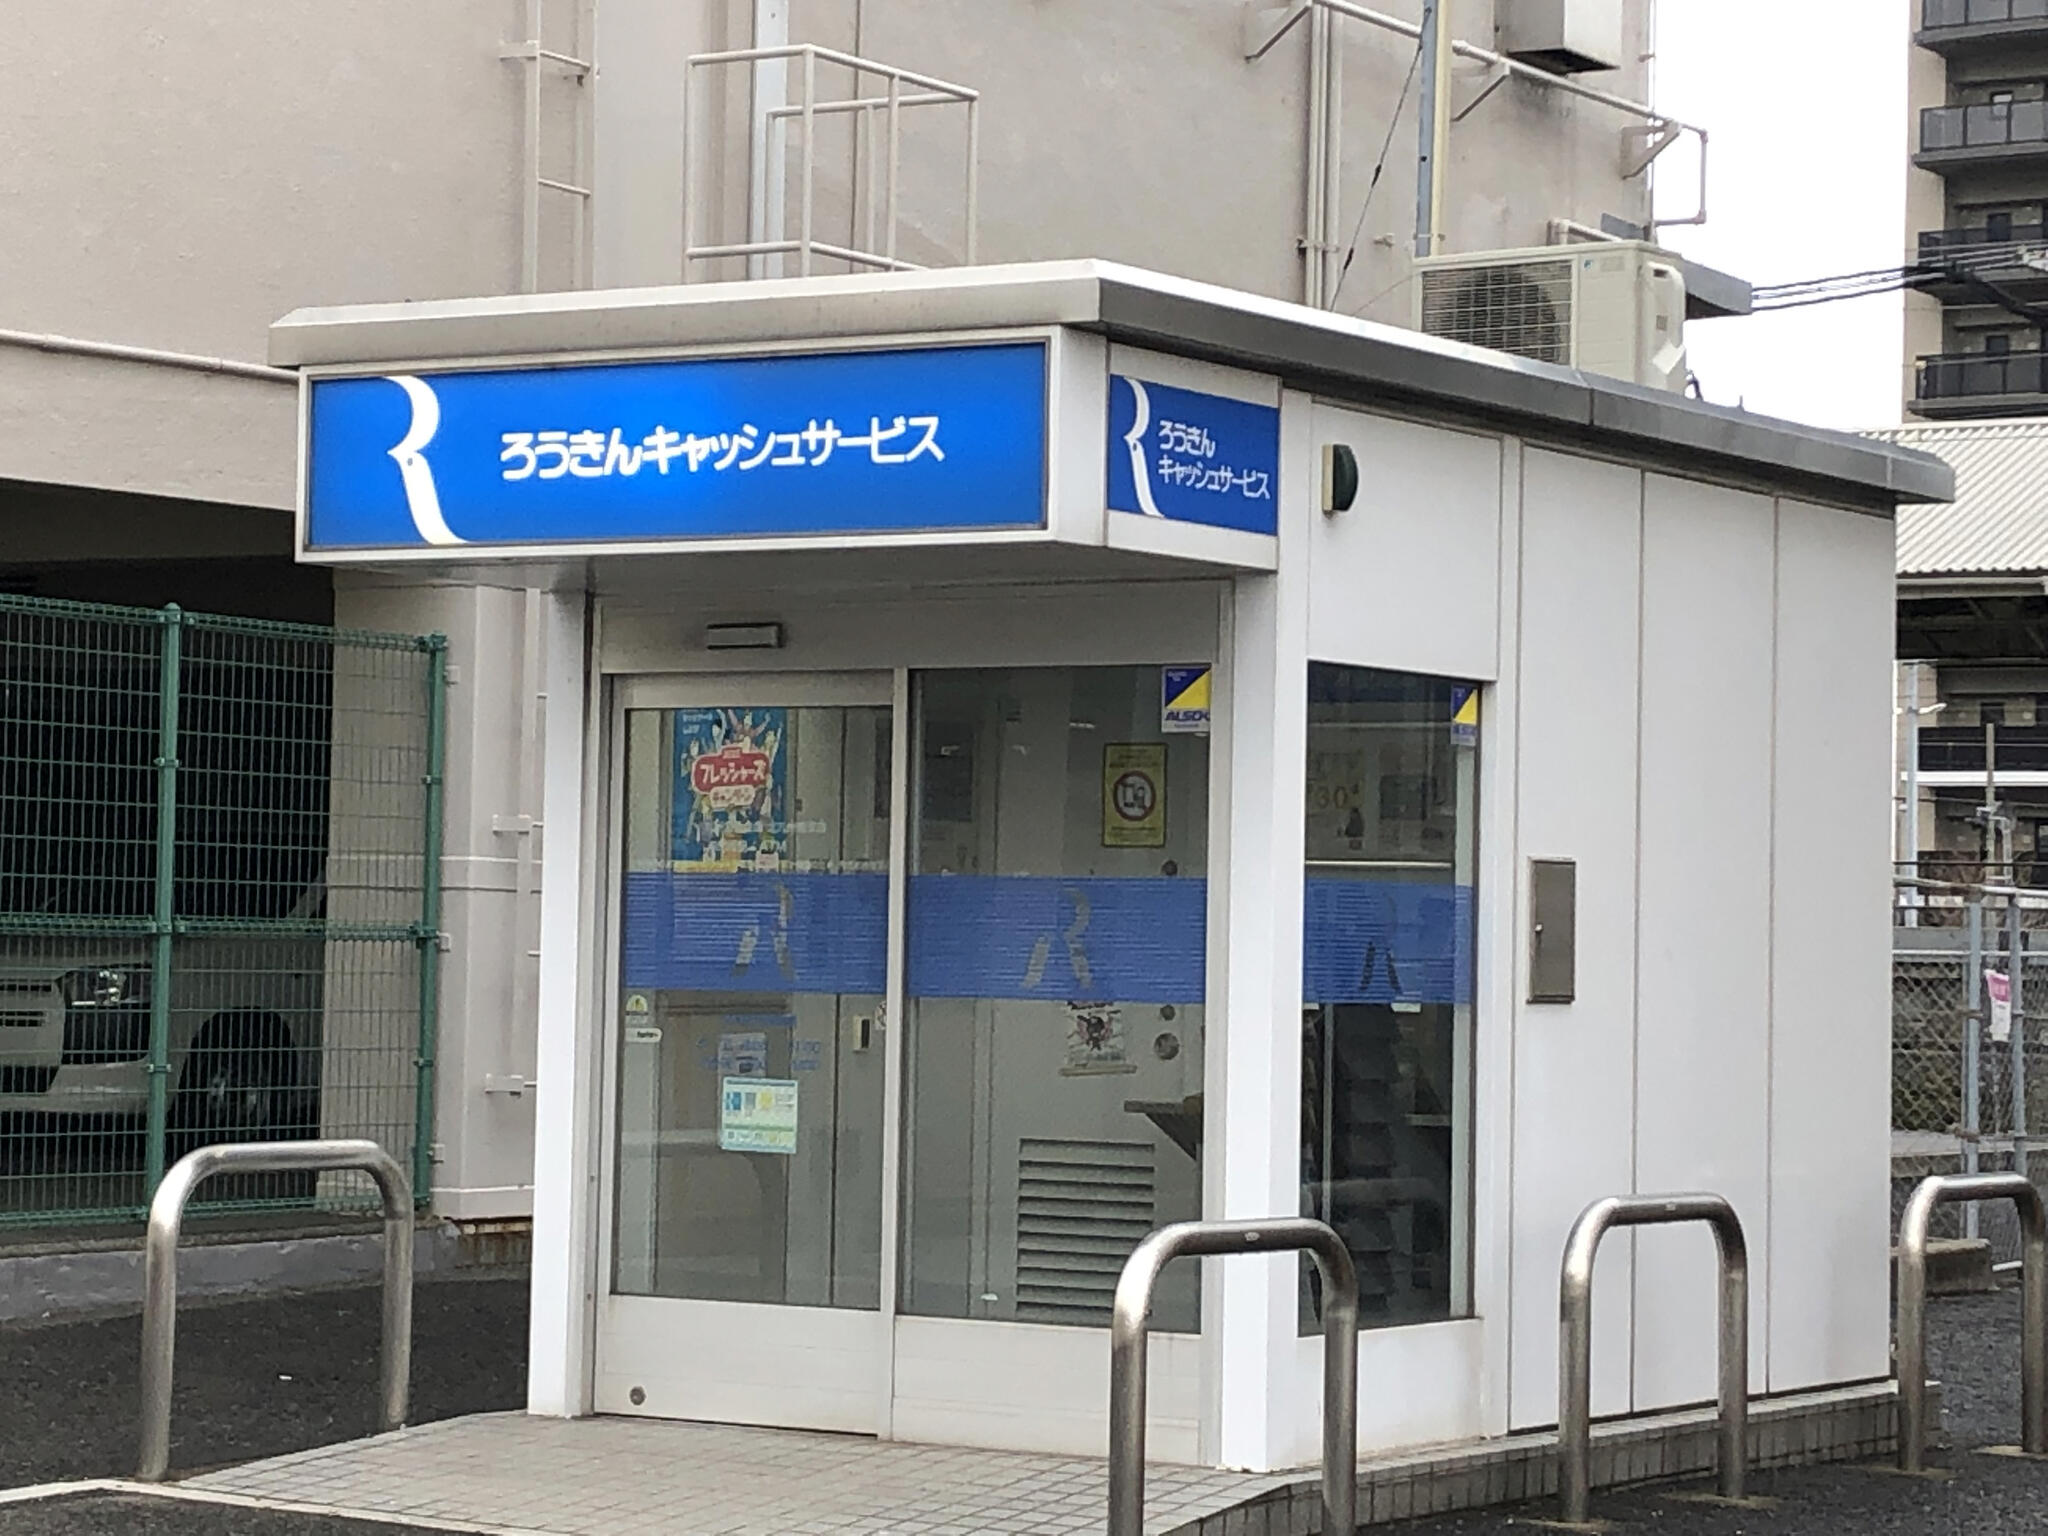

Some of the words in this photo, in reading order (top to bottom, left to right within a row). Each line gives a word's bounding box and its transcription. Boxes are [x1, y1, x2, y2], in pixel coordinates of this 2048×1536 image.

[500, 415, 945, 481] ろうきんキャッシュサービス
[1158, 420, 1216, 458] ろうきん
[1158, 455, 1271, 499] キャッシュサービス
[700, 760, 767, 784] フレッシャーズ
